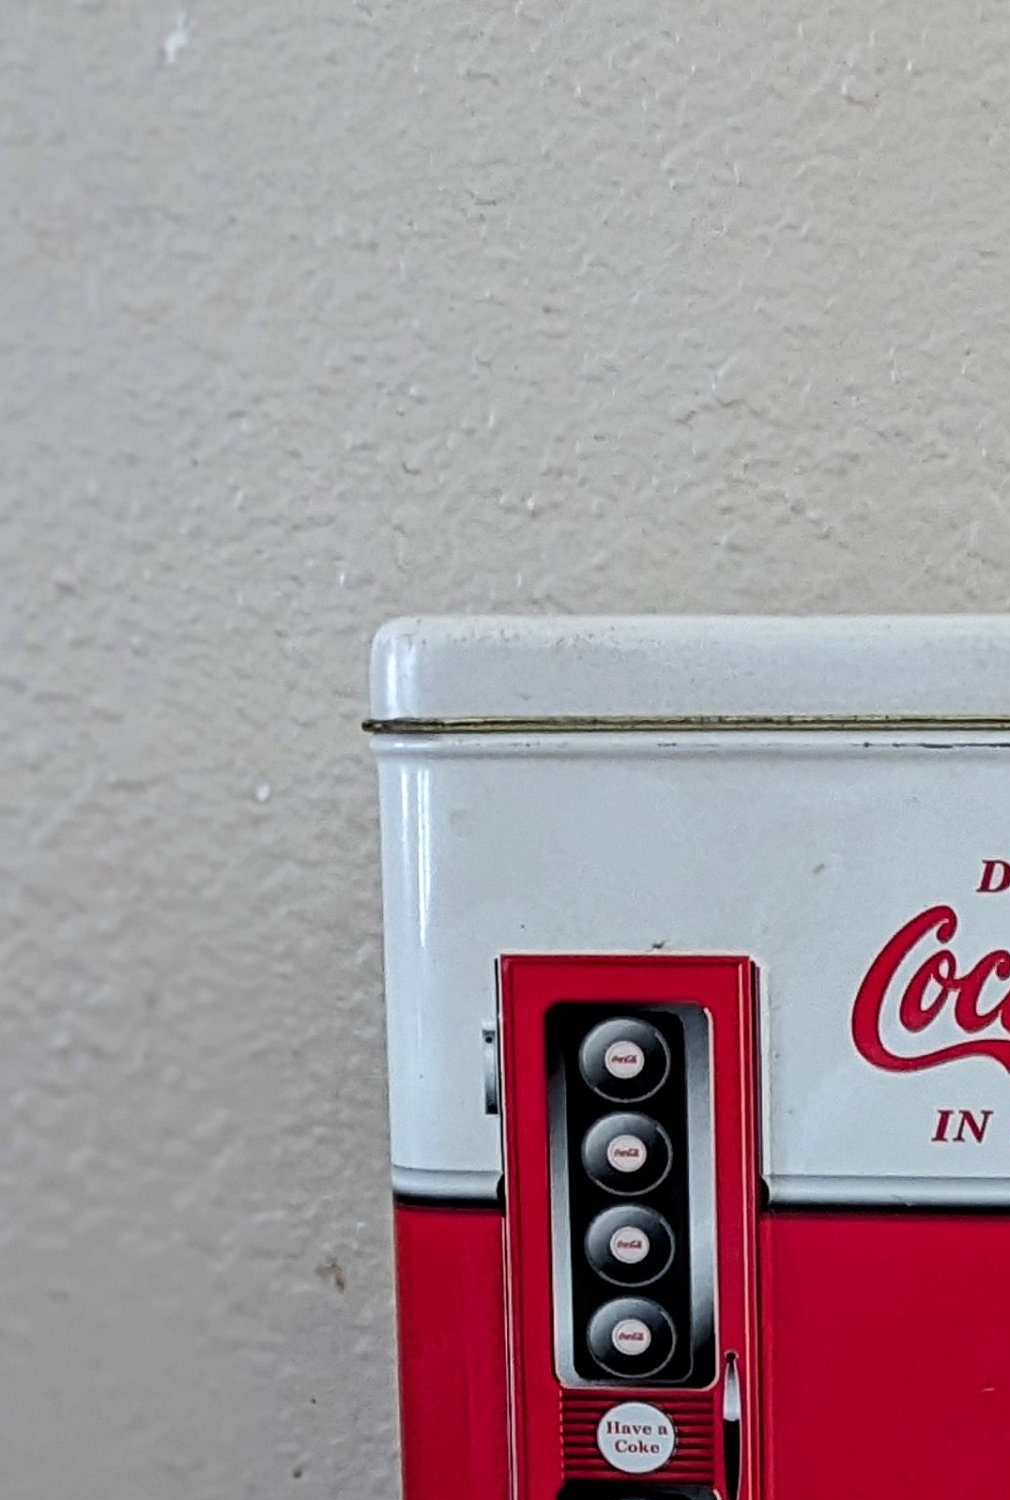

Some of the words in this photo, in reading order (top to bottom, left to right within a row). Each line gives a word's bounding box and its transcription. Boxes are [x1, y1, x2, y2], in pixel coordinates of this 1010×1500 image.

[931, 1109, 993, 1143] IN
[606, 1420, 653, 1436] Have
[657, 1425, 668, 1436] a
[614, 1439, 660, 1454] Coke
